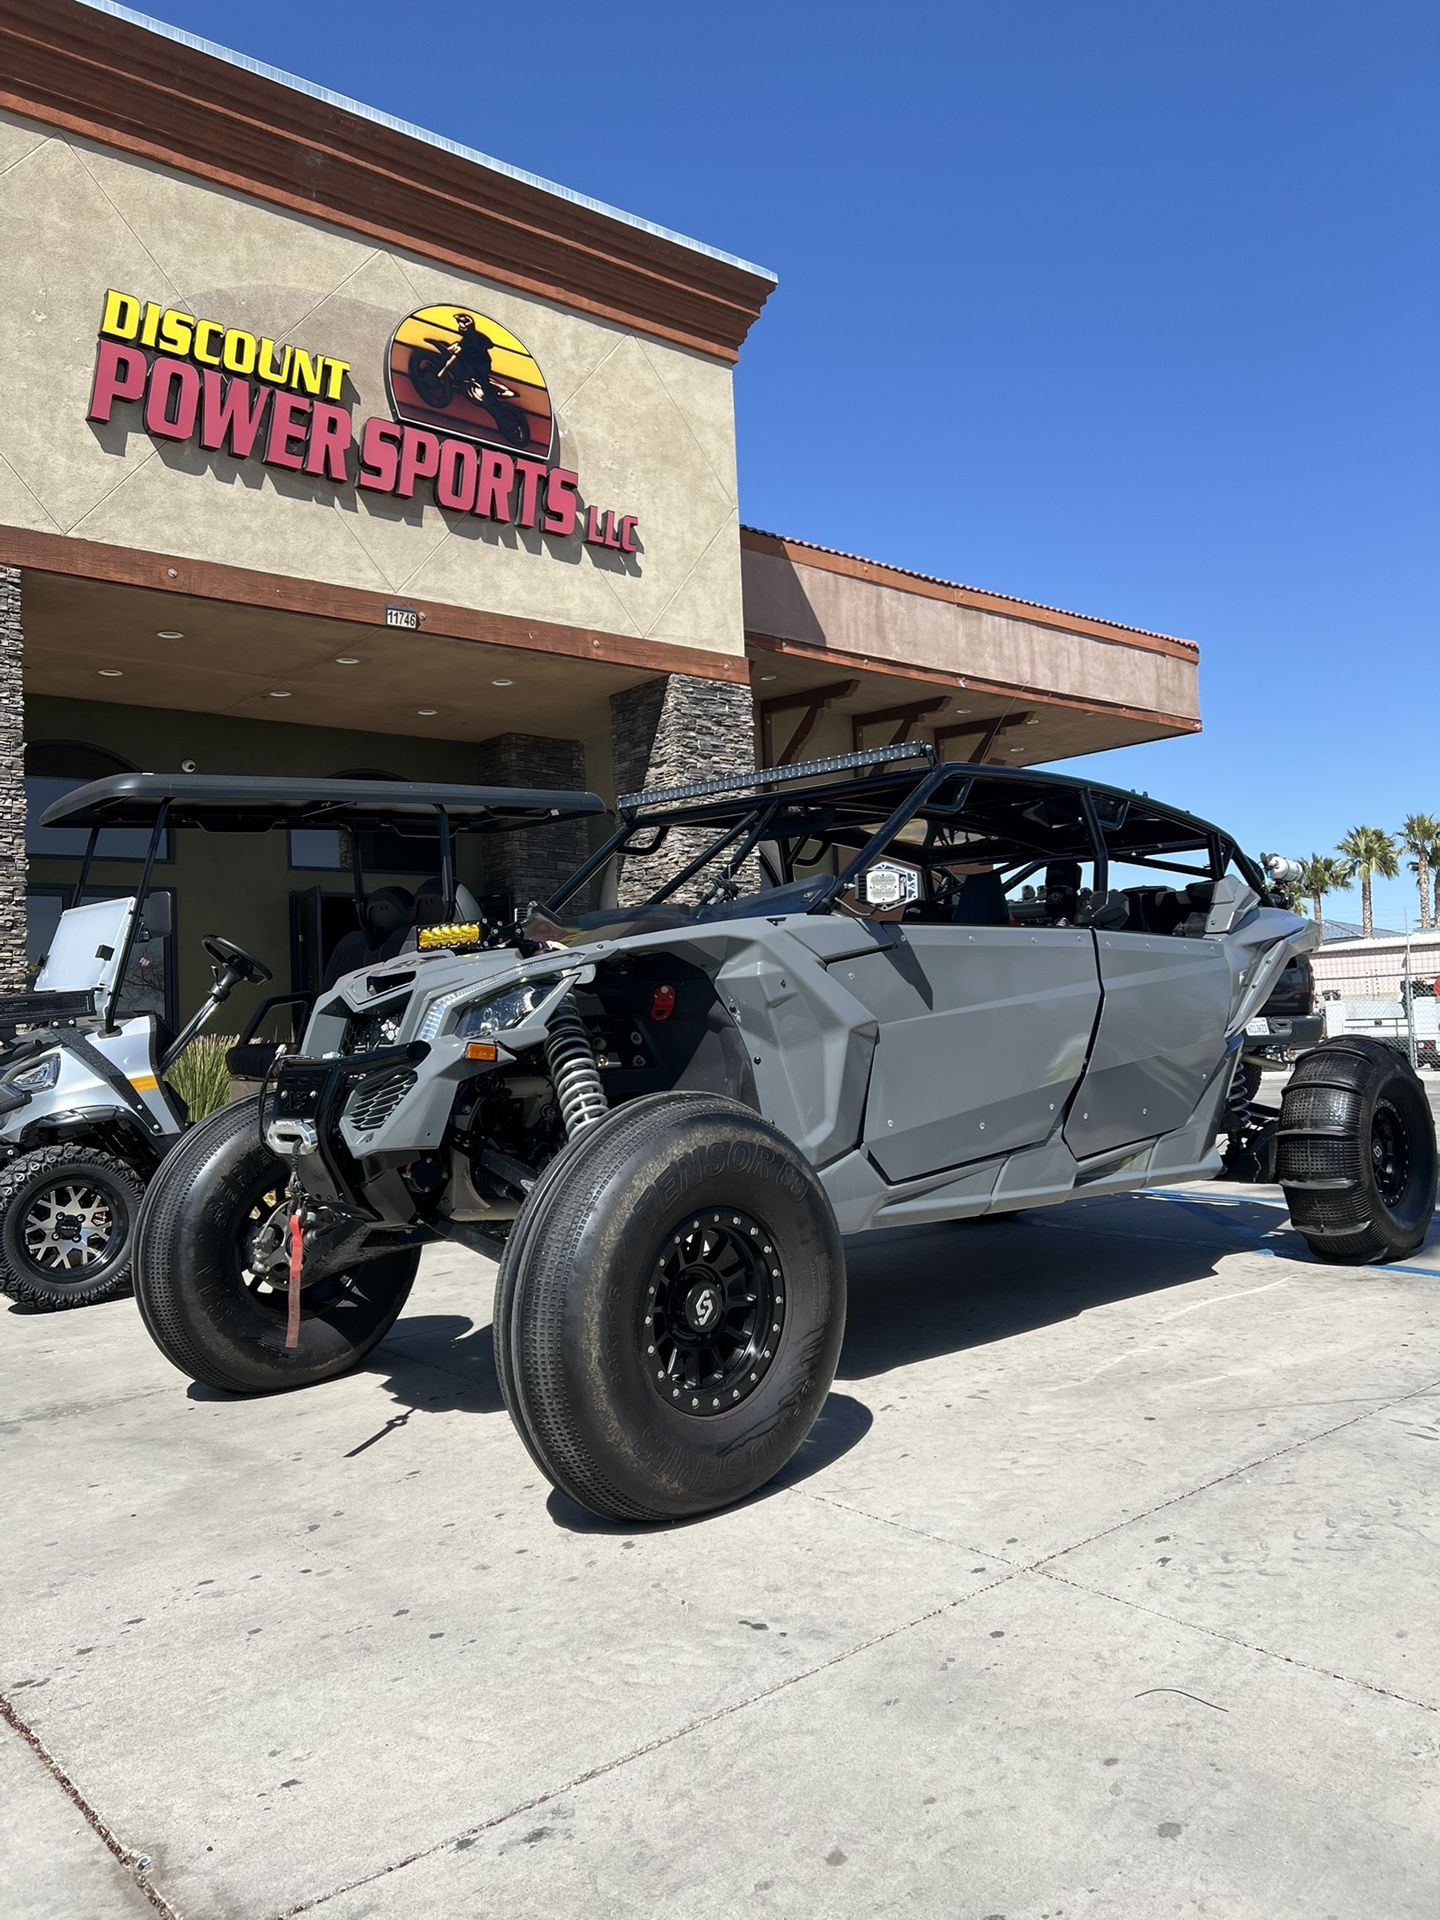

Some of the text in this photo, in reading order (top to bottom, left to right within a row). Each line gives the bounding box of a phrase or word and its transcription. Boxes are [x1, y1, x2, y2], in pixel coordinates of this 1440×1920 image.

[101, 288, 350, 401] DISCOUNT
[88, 337, 639, 552] POWER SPORTS LLC
[387, 610, 416, 627] 11746
[632, 1140, 776, 1217] TENSOR
